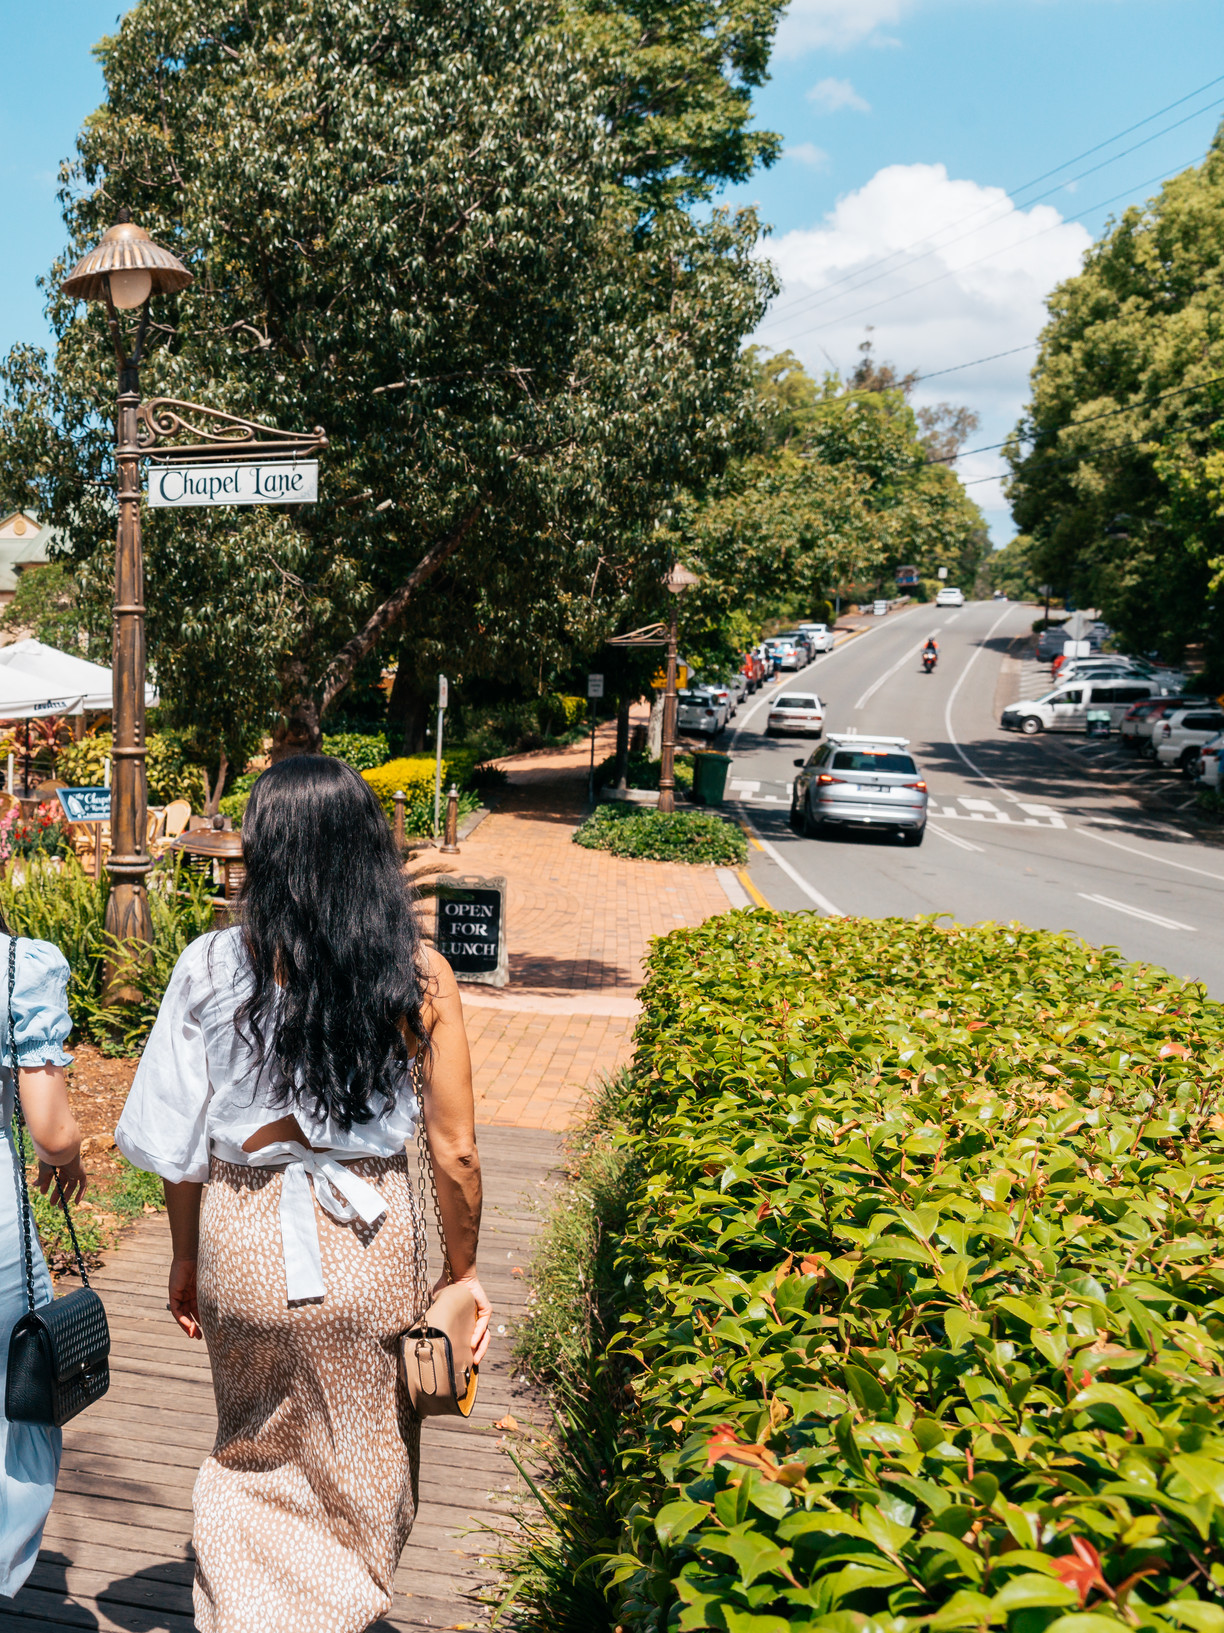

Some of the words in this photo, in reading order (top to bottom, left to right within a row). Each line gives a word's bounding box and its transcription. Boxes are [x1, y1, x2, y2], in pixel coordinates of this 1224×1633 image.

[160, 467, 240, 501] Chapel
[249, 467, 303, 499] Lane
[444, 903, 494, 918] OPEN
[450, 922, 488, 936] FOR
[441, 942, 496, 956] LUNCH
